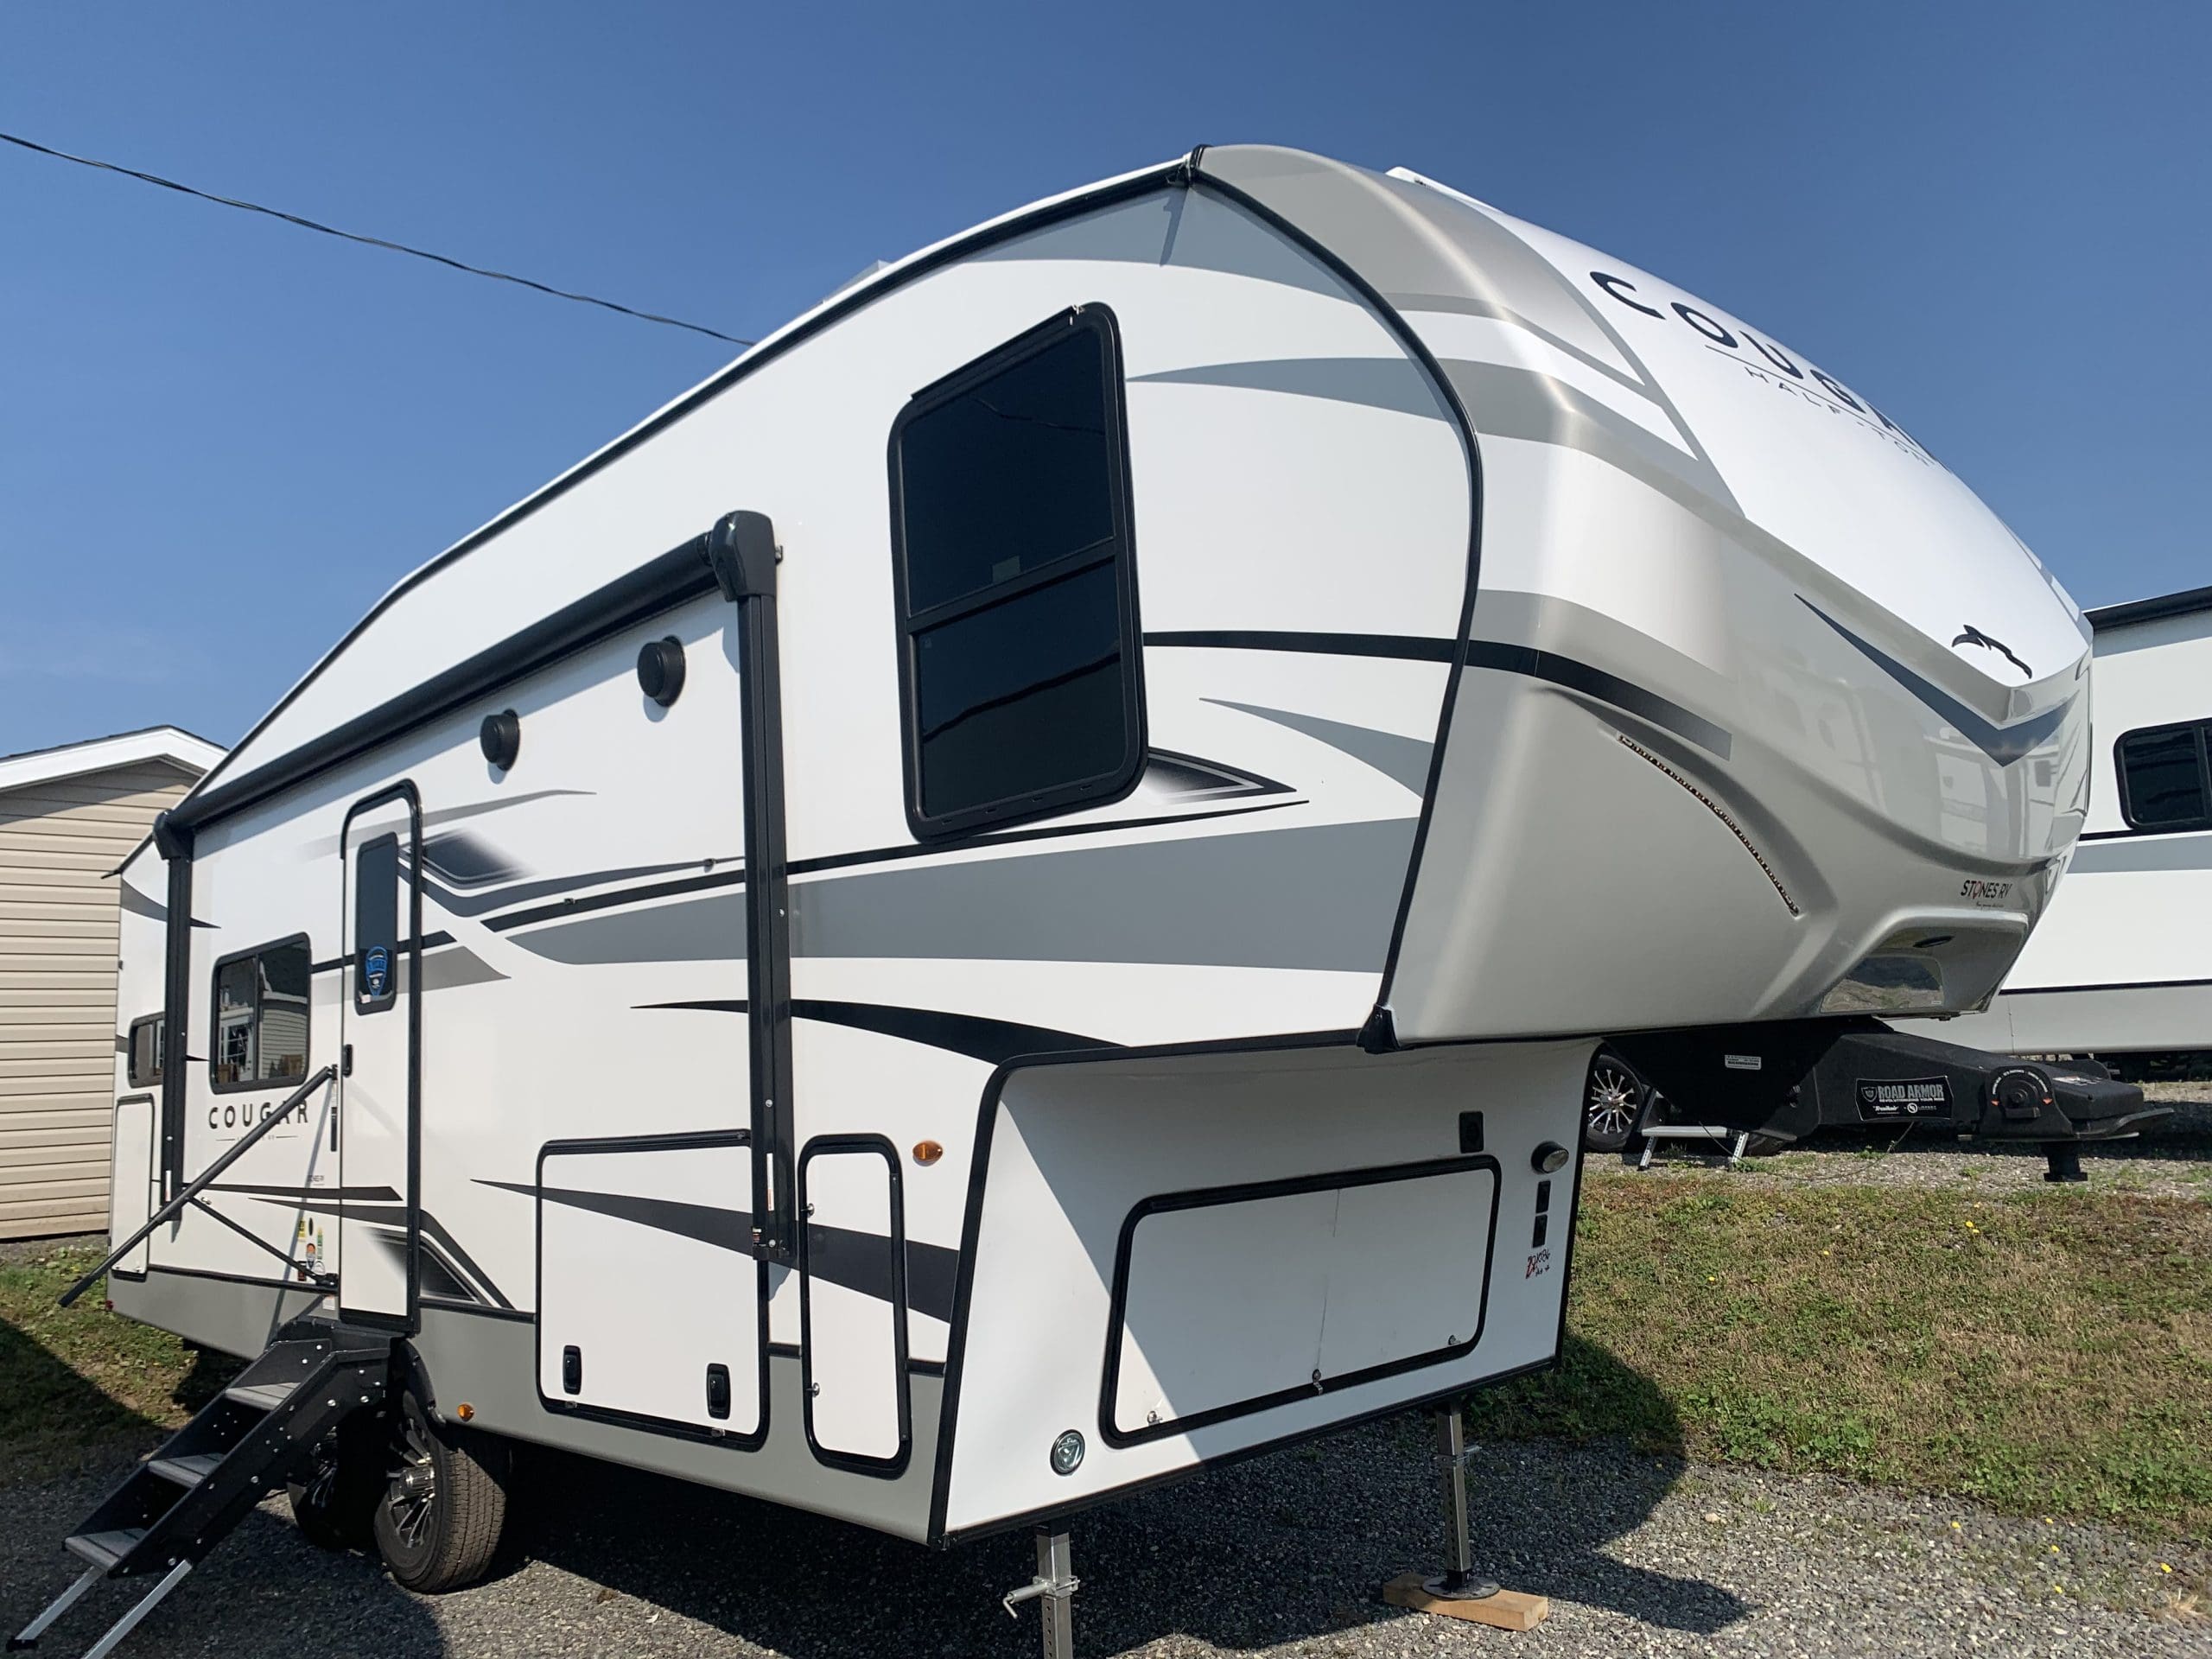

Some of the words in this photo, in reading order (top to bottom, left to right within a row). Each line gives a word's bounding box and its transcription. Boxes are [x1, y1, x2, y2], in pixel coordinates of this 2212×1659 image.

[1590, 270, 1953, 474] COUGA
[1960, 880, 1999, 899] STONES
[1998, 883, 2013, 899] RV
[1877, 1085, 1906, 1100] ROAD
[1907, 1084, 1945, 1099] ARMOR
